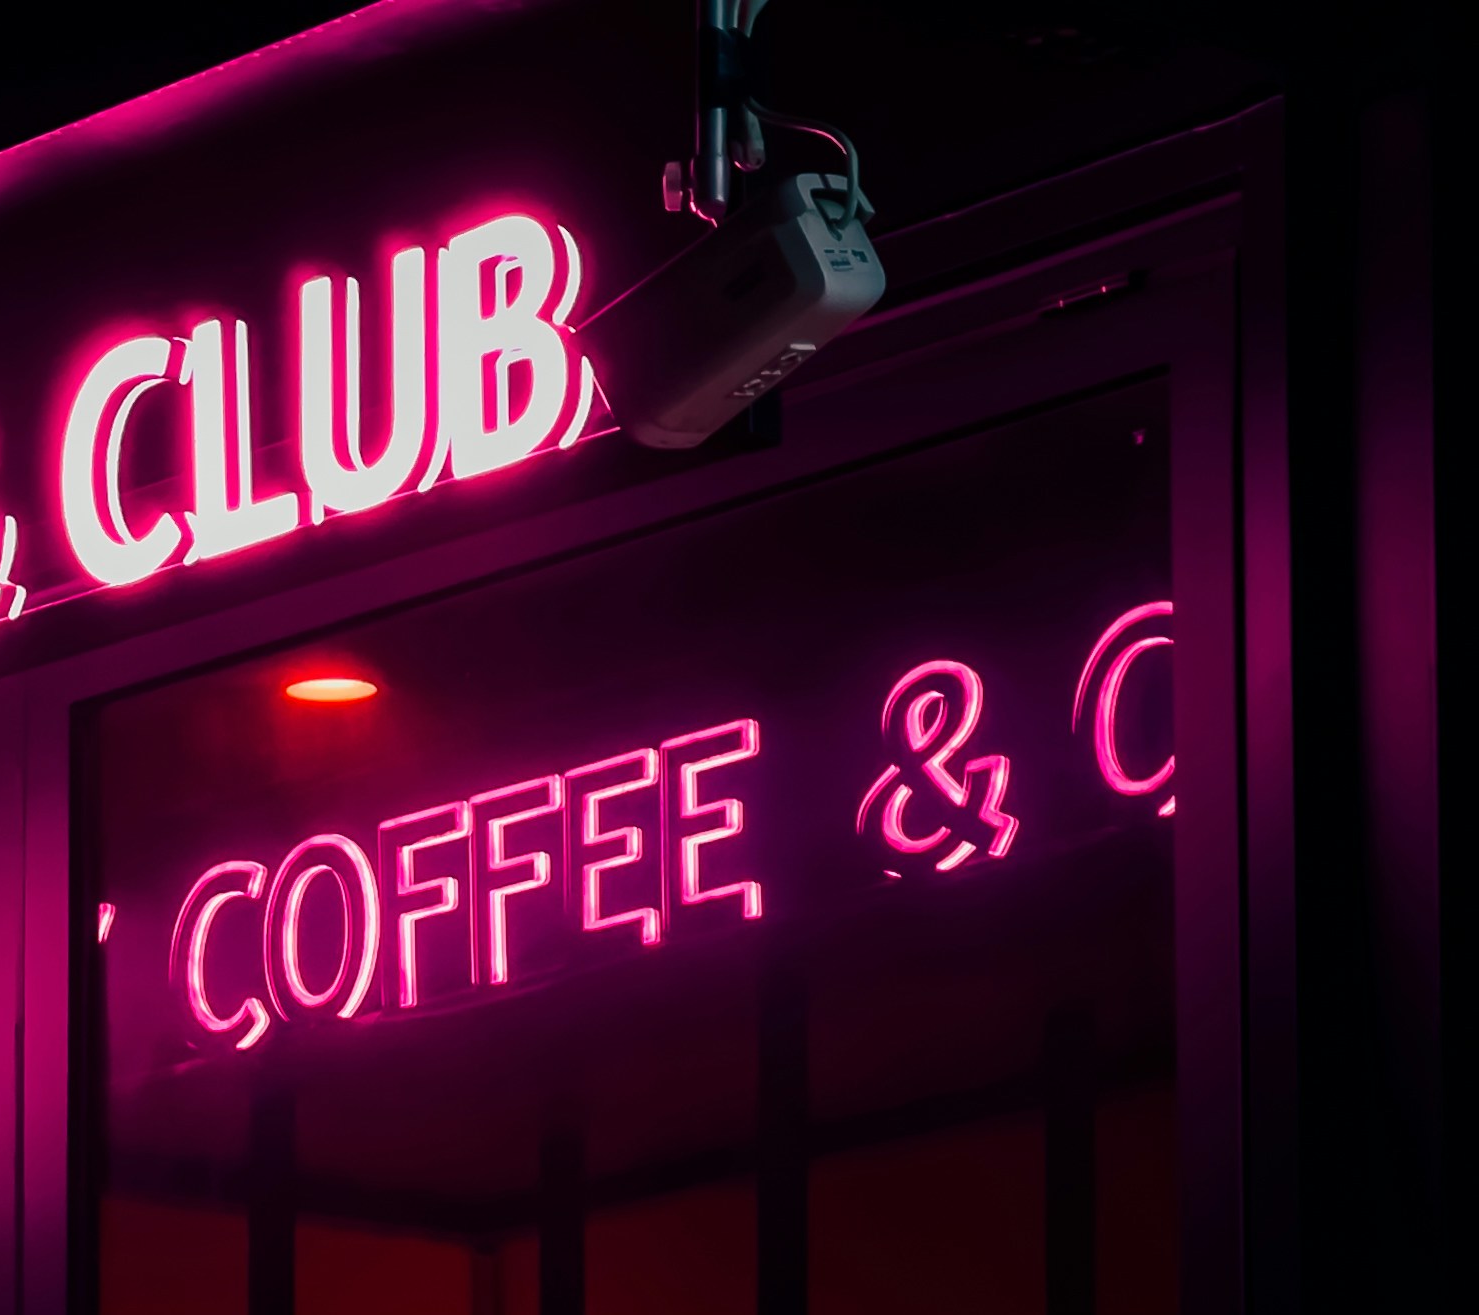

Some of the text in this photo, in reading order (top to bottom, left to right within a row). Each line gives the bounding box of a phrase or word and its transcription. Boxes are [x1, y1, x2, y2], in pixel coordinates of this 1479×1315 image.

[60, 214, 597, 589] CLUB
[168, 718, 763, 1052] COFFEE
[855, 658, 1020, 873] &
